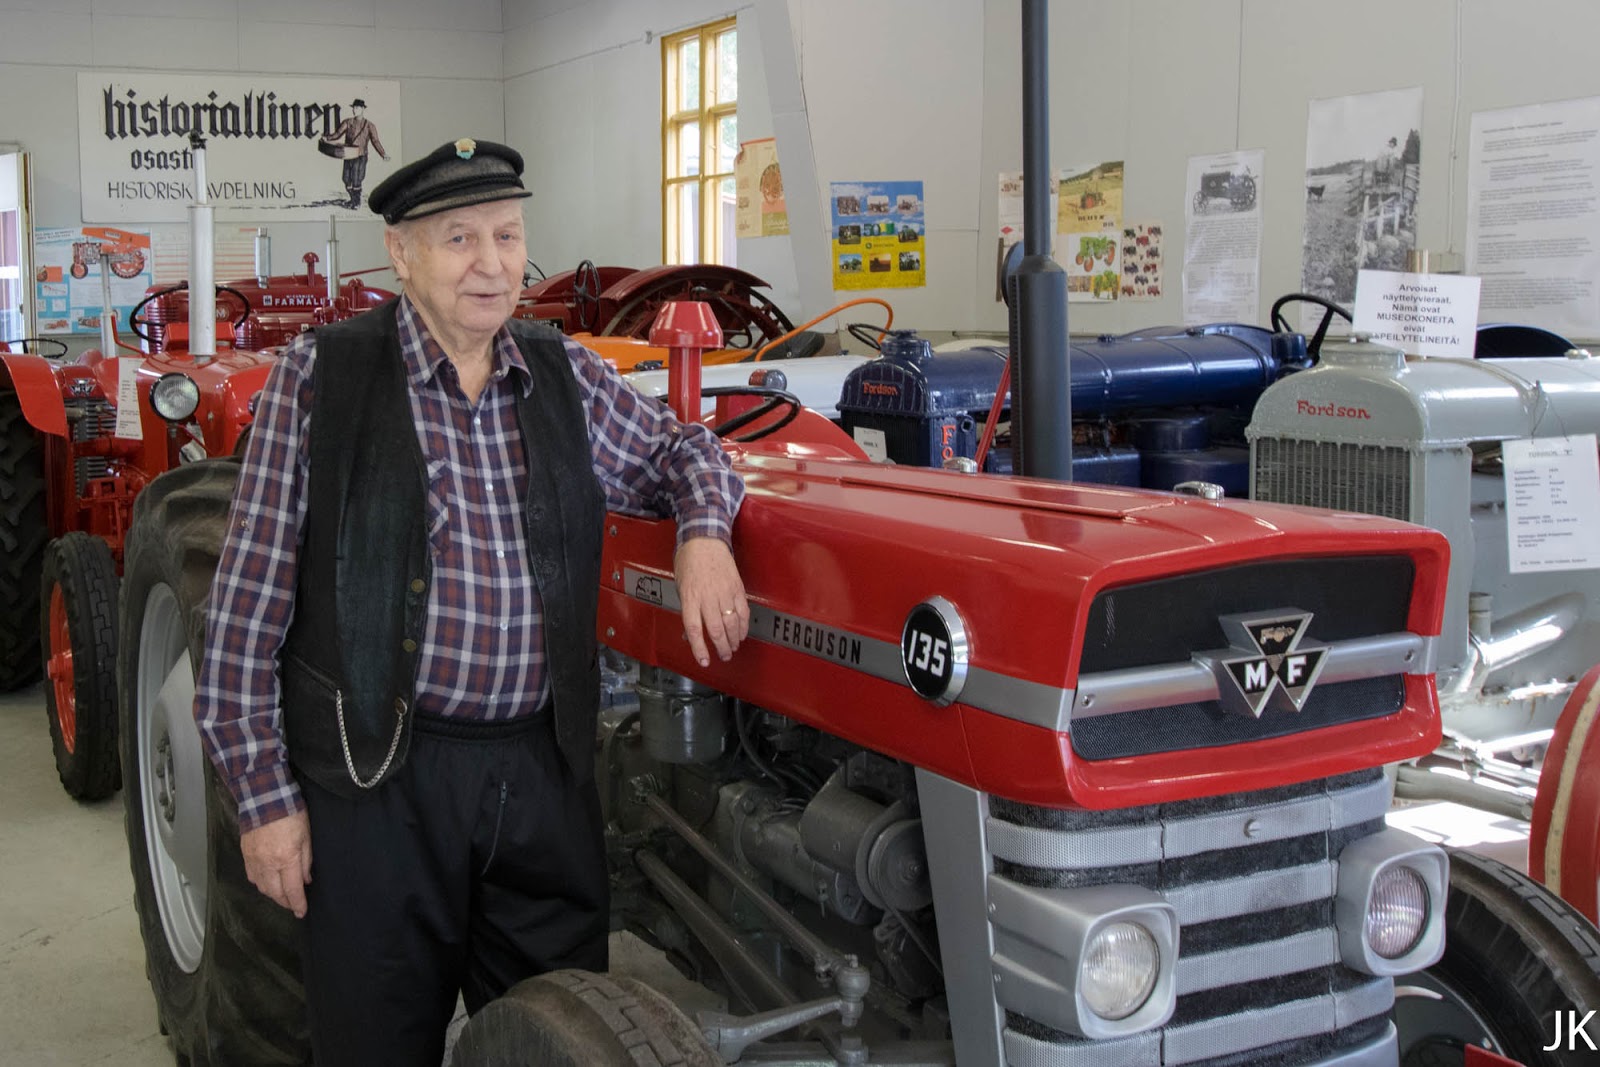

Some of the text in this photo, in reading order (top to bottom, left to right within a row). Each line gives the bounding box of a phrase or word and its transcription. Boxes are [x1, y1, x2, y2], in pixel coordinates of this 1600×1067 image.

[103, 83, 341, 140] historiallinen
[108, 181, 193, 199] HISTORISK
[1399, 284, 1437, 292] Arvoisat
[1392, 303, 1418, 312] Nämä
[862, 380, 898, 396] Fordson
[1296, 399, 1371, 420] Fordson
[772, 615, 861, 665] FERGUSON
[908, 630, 948, 677] 135
